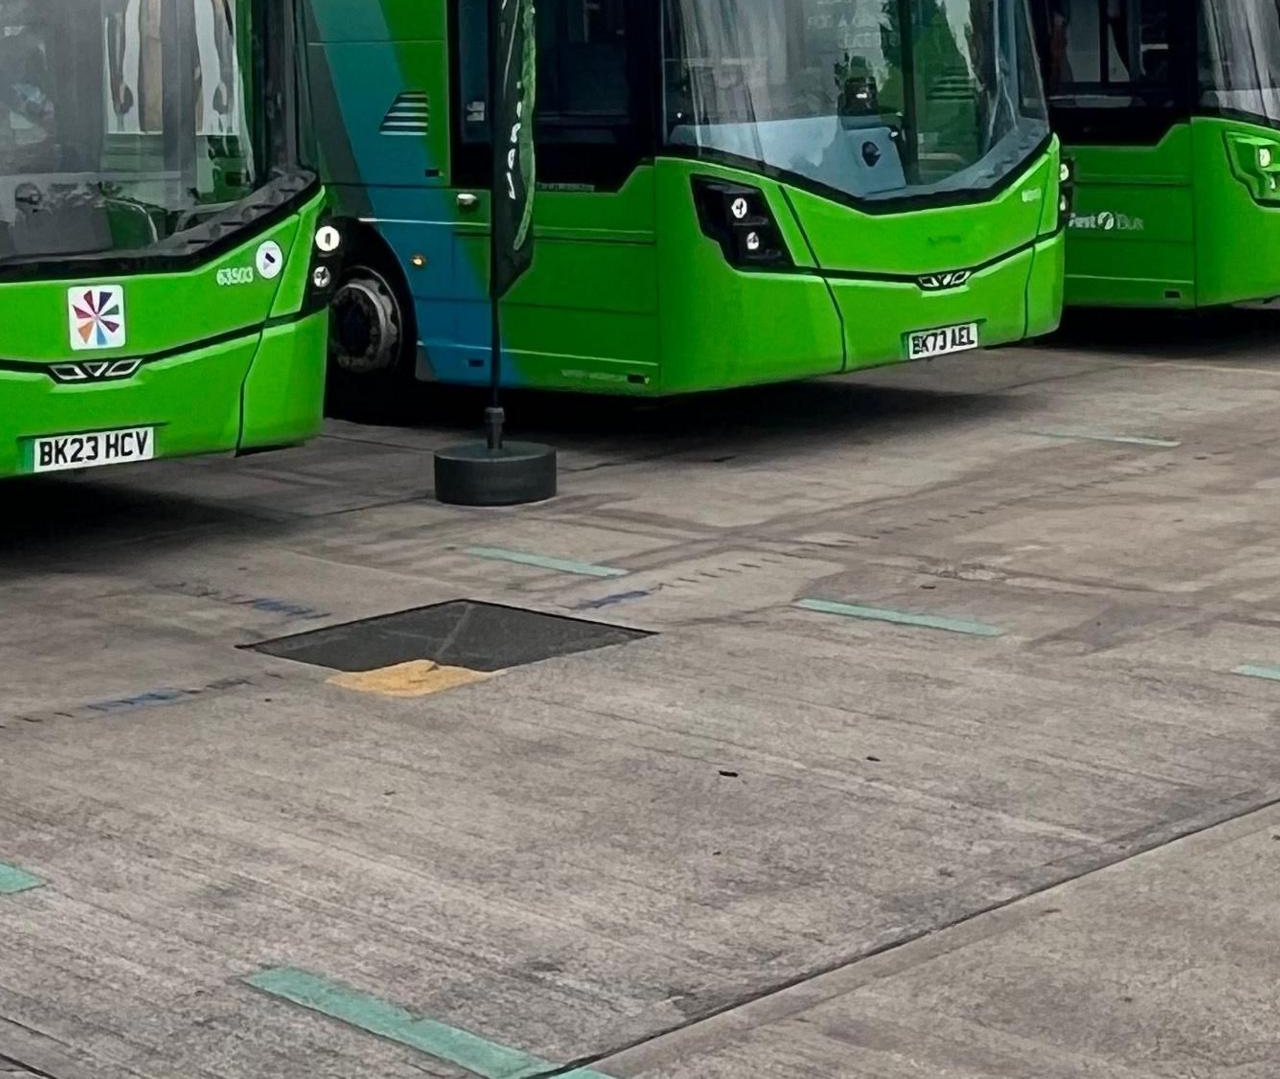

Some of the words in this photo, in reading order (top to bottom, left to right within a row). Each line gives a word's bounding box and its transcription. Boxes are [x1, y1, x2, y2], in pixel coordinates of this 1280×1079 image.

[912, 332, 948, 355] BK73
[39, 435, 99, 466] BK23
[105, 430, 148, 458] HCV
